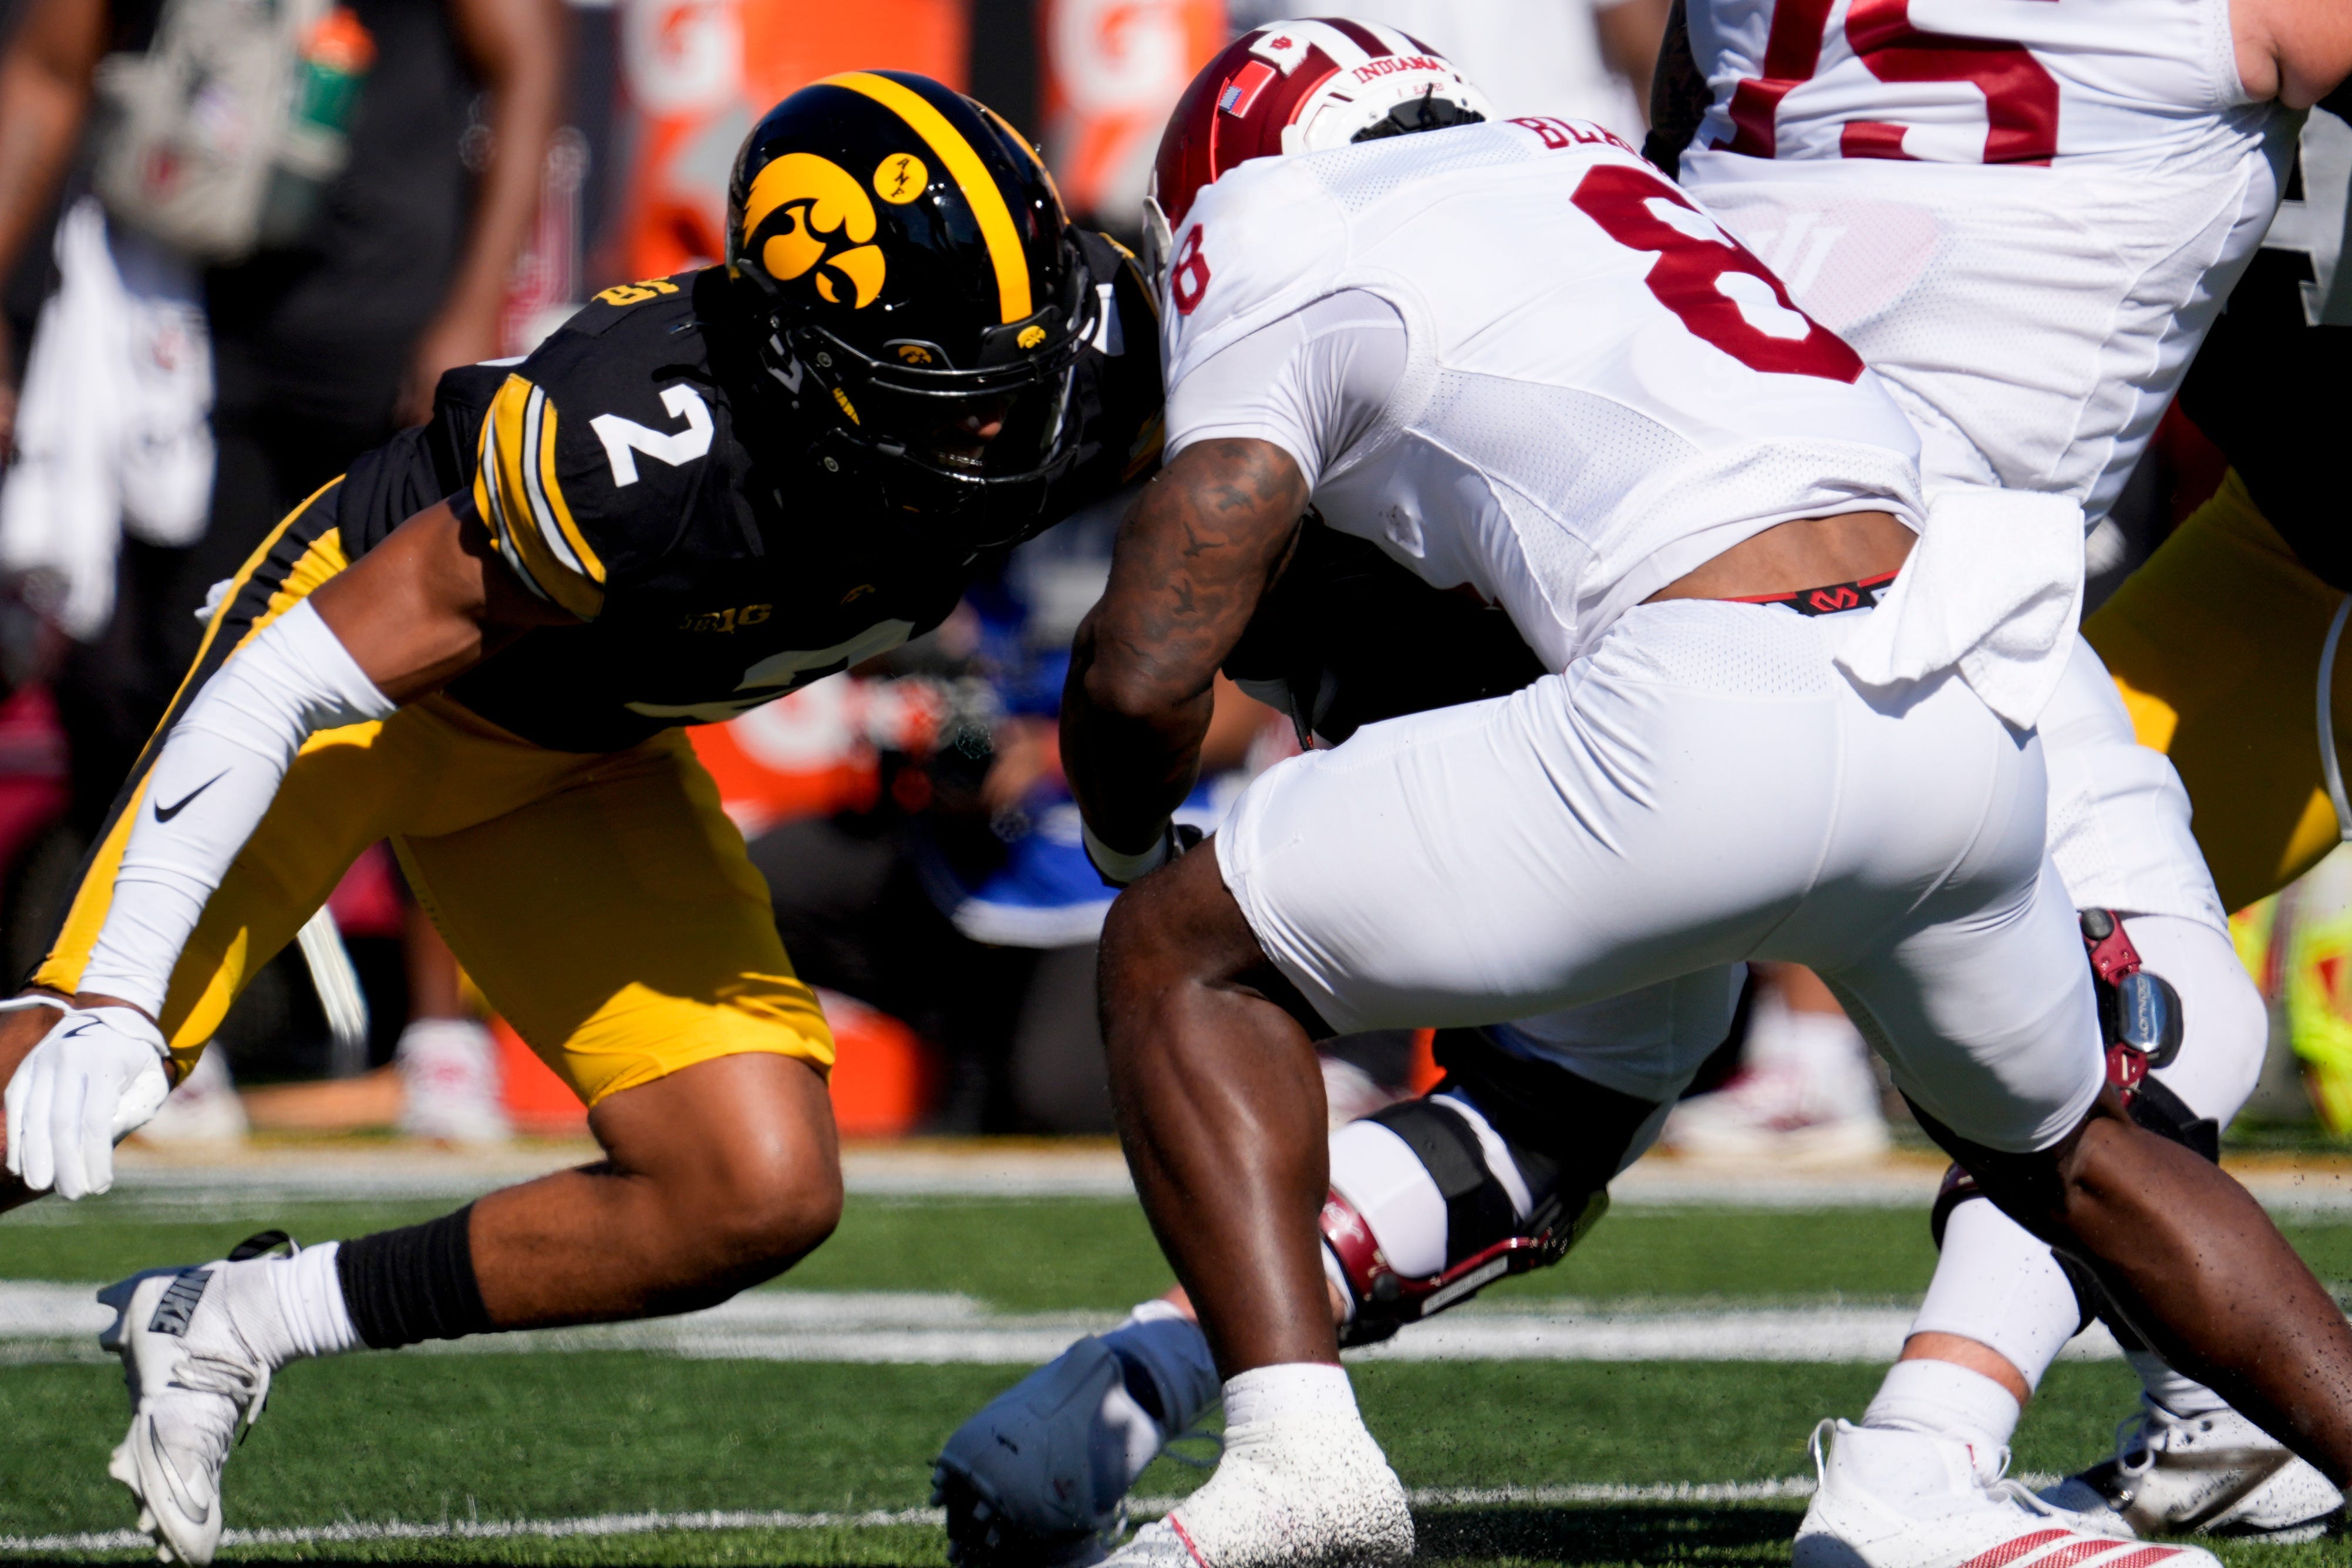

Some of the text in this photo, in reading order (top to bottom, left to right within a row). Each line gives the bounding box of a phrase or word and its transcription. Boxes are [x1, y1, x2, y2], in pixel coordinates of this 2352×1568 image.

[1352, 56, 1446, 84] INDIANA
[1171, 222, 1211, 316] 8
[1570, 164, 1865, 385] 8
[589, 383, 715, 488] 2
[148, 1266, 215, 1338] NIKE
